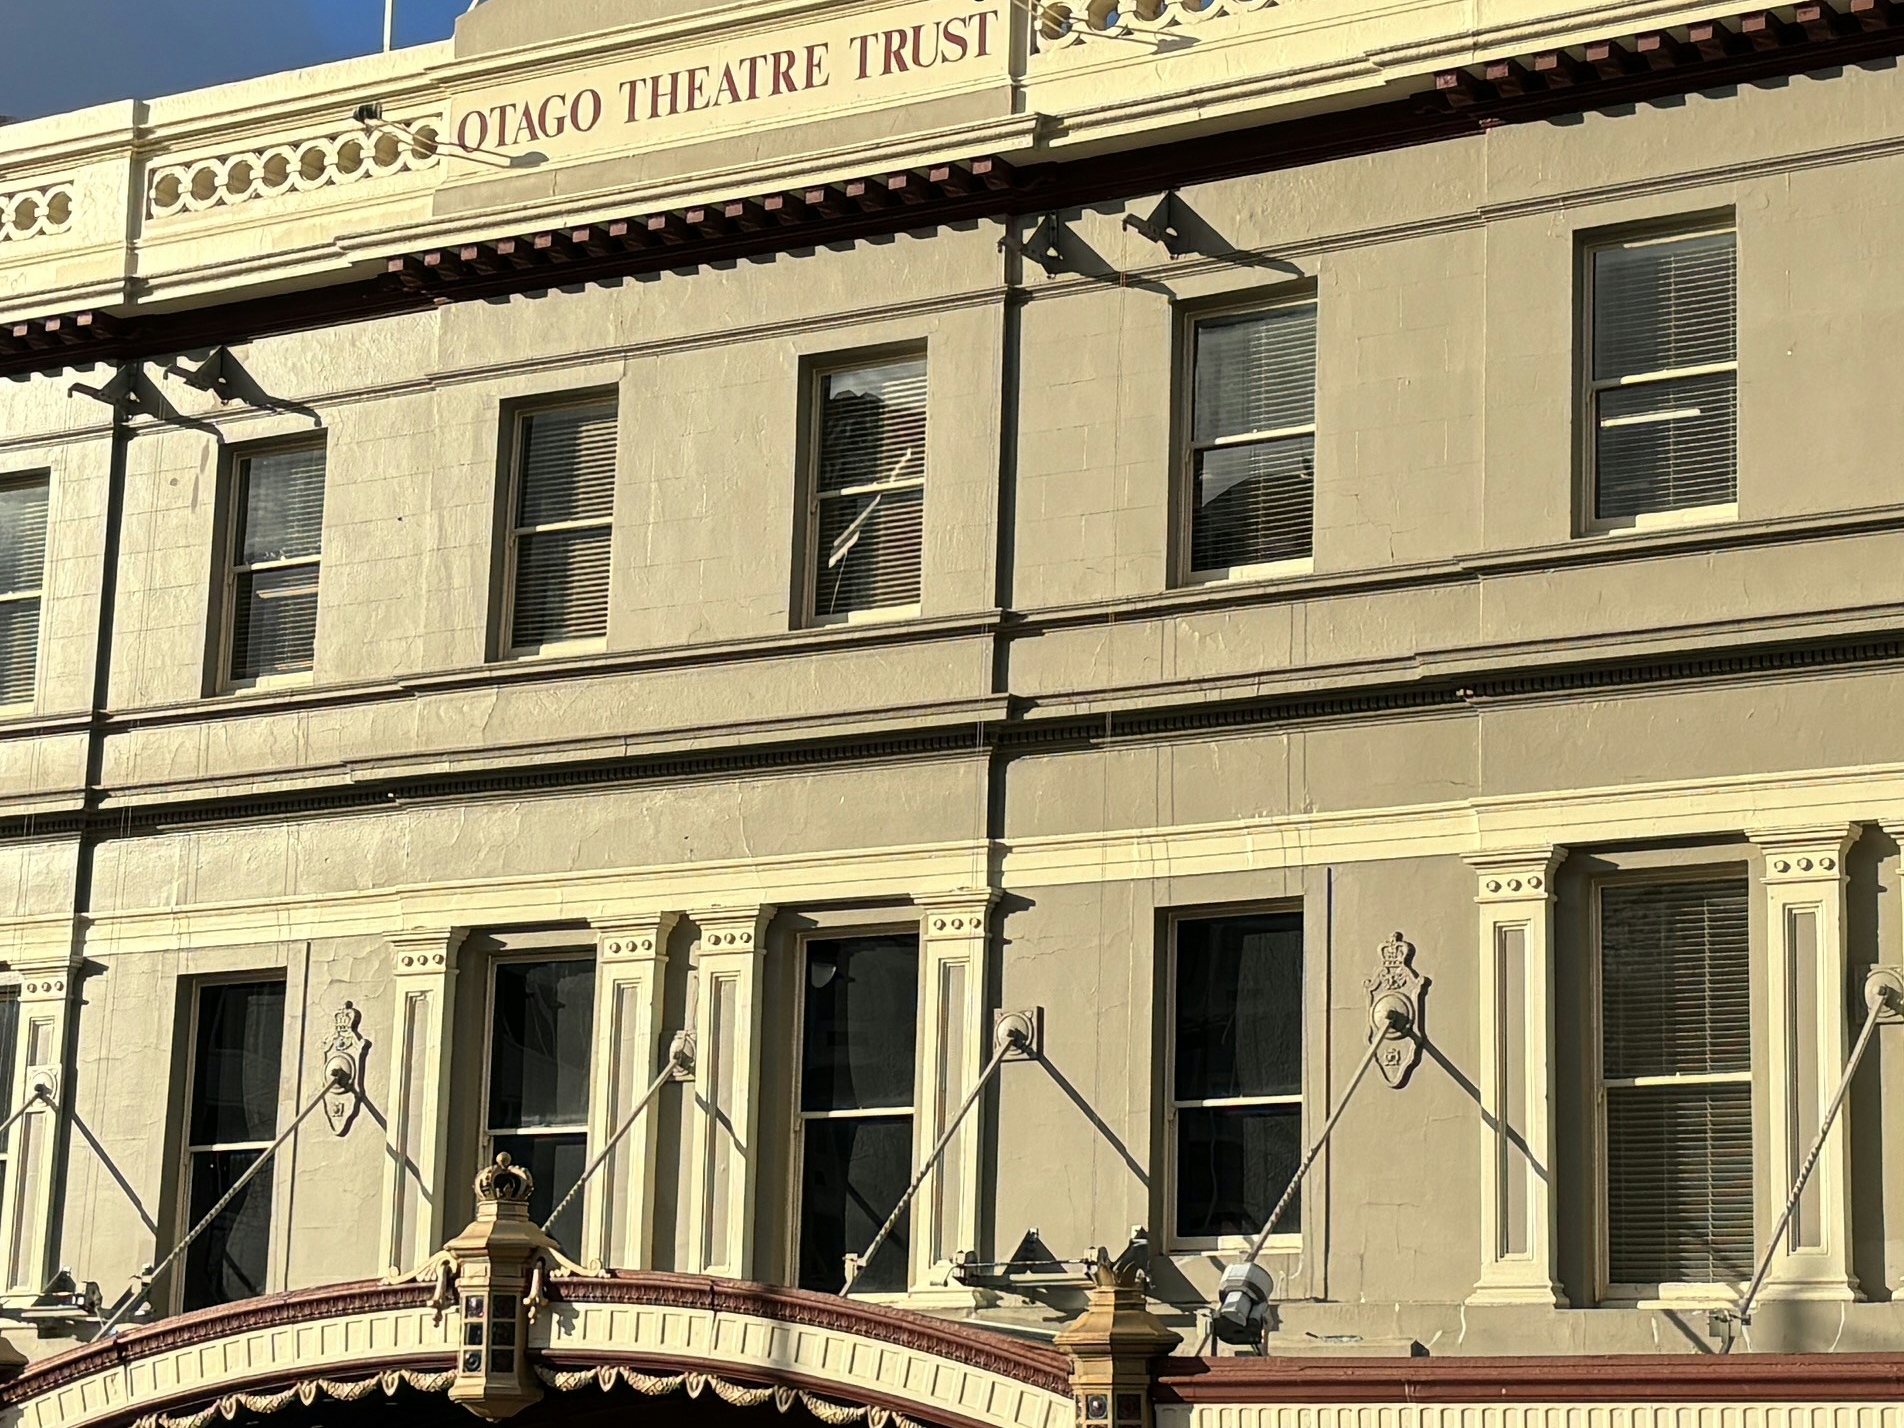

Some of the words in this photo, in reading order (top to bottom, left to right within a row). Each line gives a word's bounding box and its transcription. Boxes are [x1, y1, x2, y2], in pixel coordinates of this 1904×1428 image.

[457, 87, 602, 154] OTAGO
[619, 42, 830, 124] THEATRE
[849, 9, 1000, 80] TRUST
